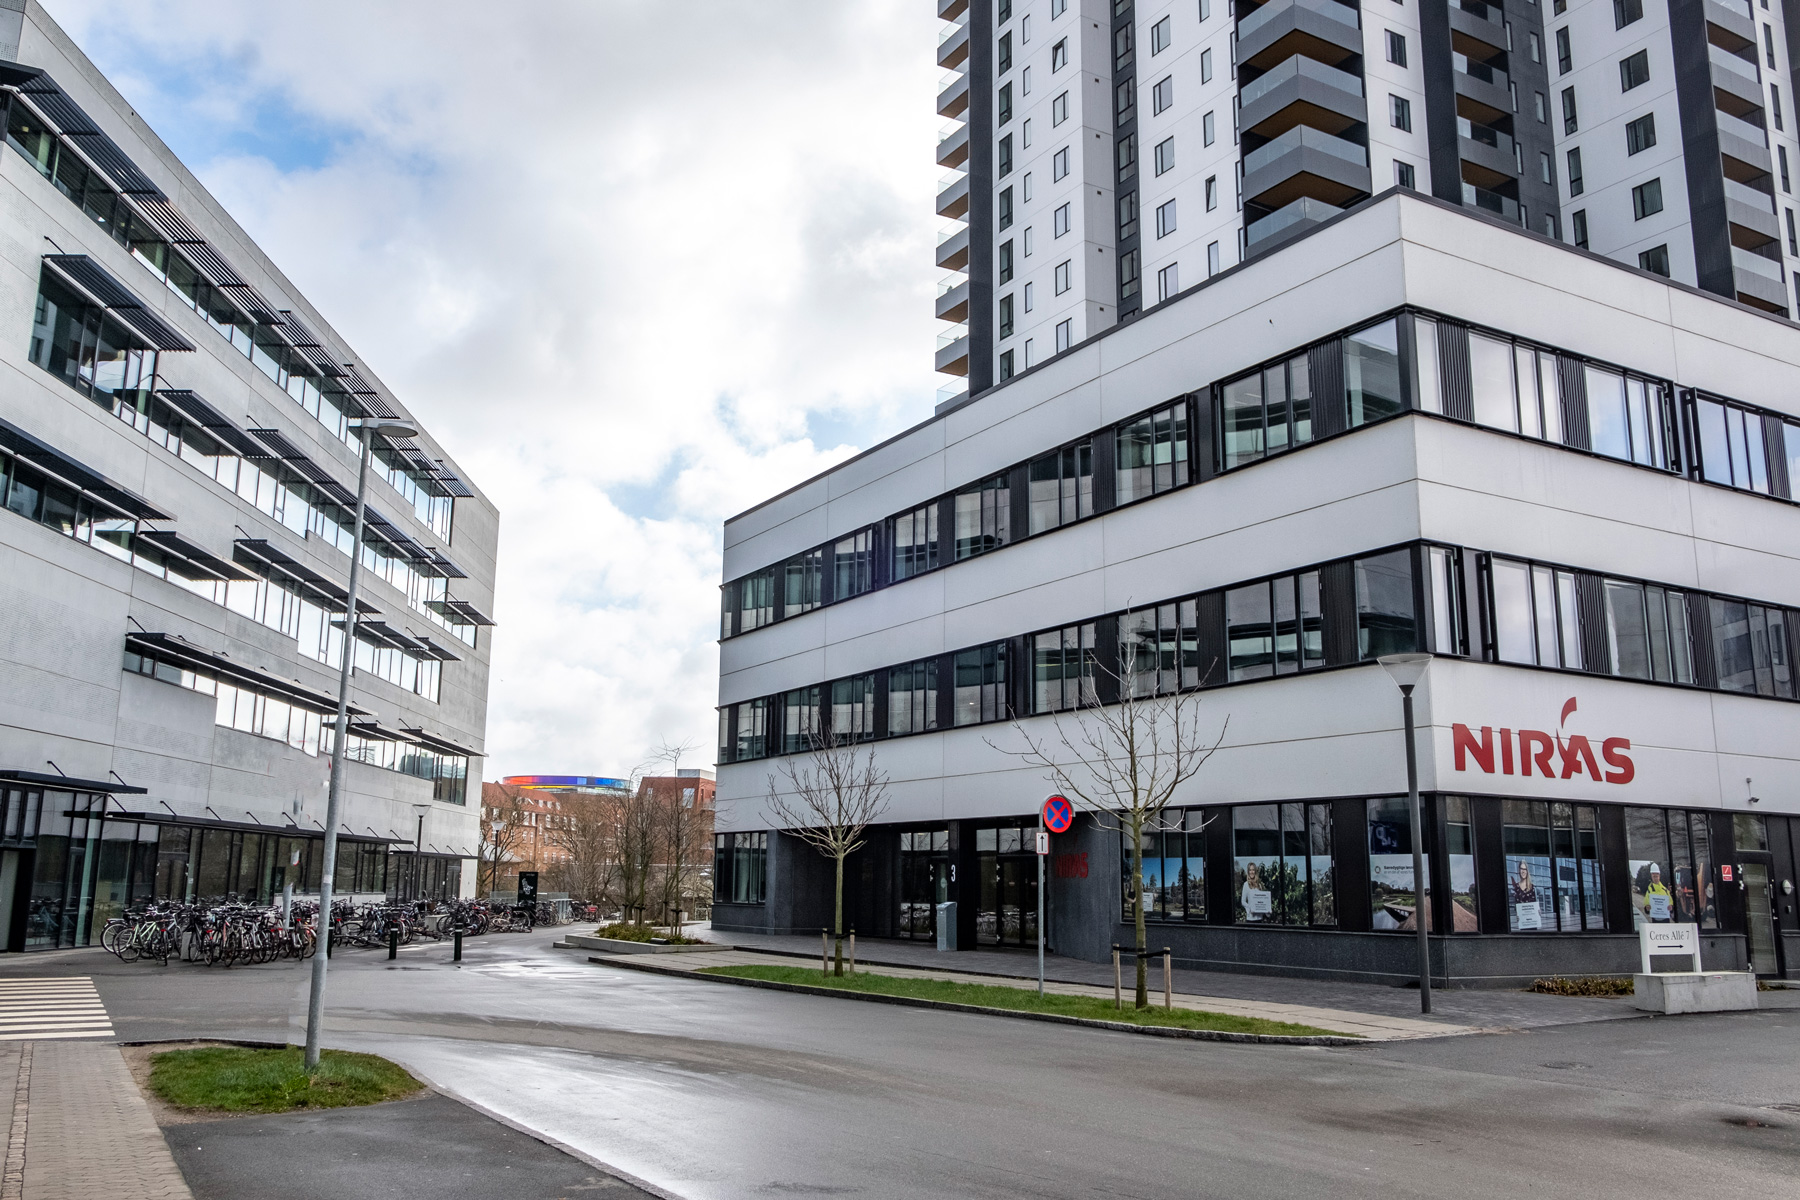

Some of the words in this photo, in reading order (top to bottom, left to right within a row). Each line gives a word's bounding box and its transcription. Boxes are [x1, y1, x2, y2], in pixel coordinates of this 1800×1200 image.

[1452, 697, 1635, 784] NIRAS
[951, 864, 956, 882] 3
[1650, 930, 1669, 940] Ceres
[1671, 930, 1684, 940] Allé
[1686, 930, 1690, 940] 7
